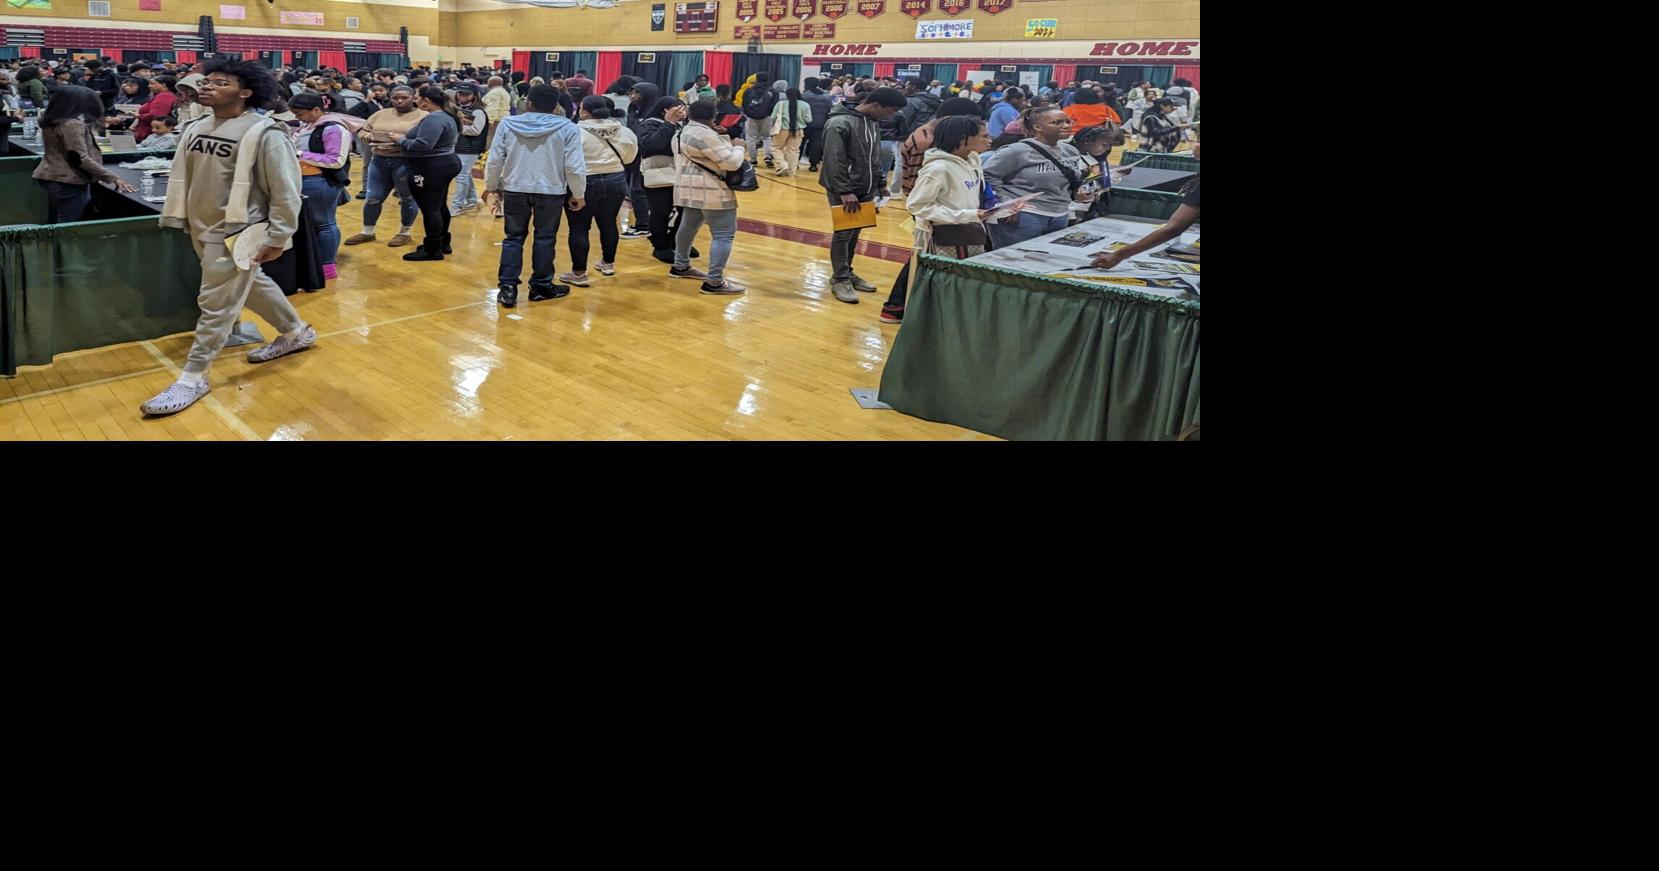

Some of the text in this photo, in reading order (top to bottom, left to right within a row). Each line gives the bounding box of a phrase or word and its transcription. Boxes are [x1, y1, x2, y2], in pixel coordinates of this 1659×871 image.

[813, 44, 882, 55] HOME
[1089, 42, 1199, 55] HOME
[187, 134, 236, 158] VANS
